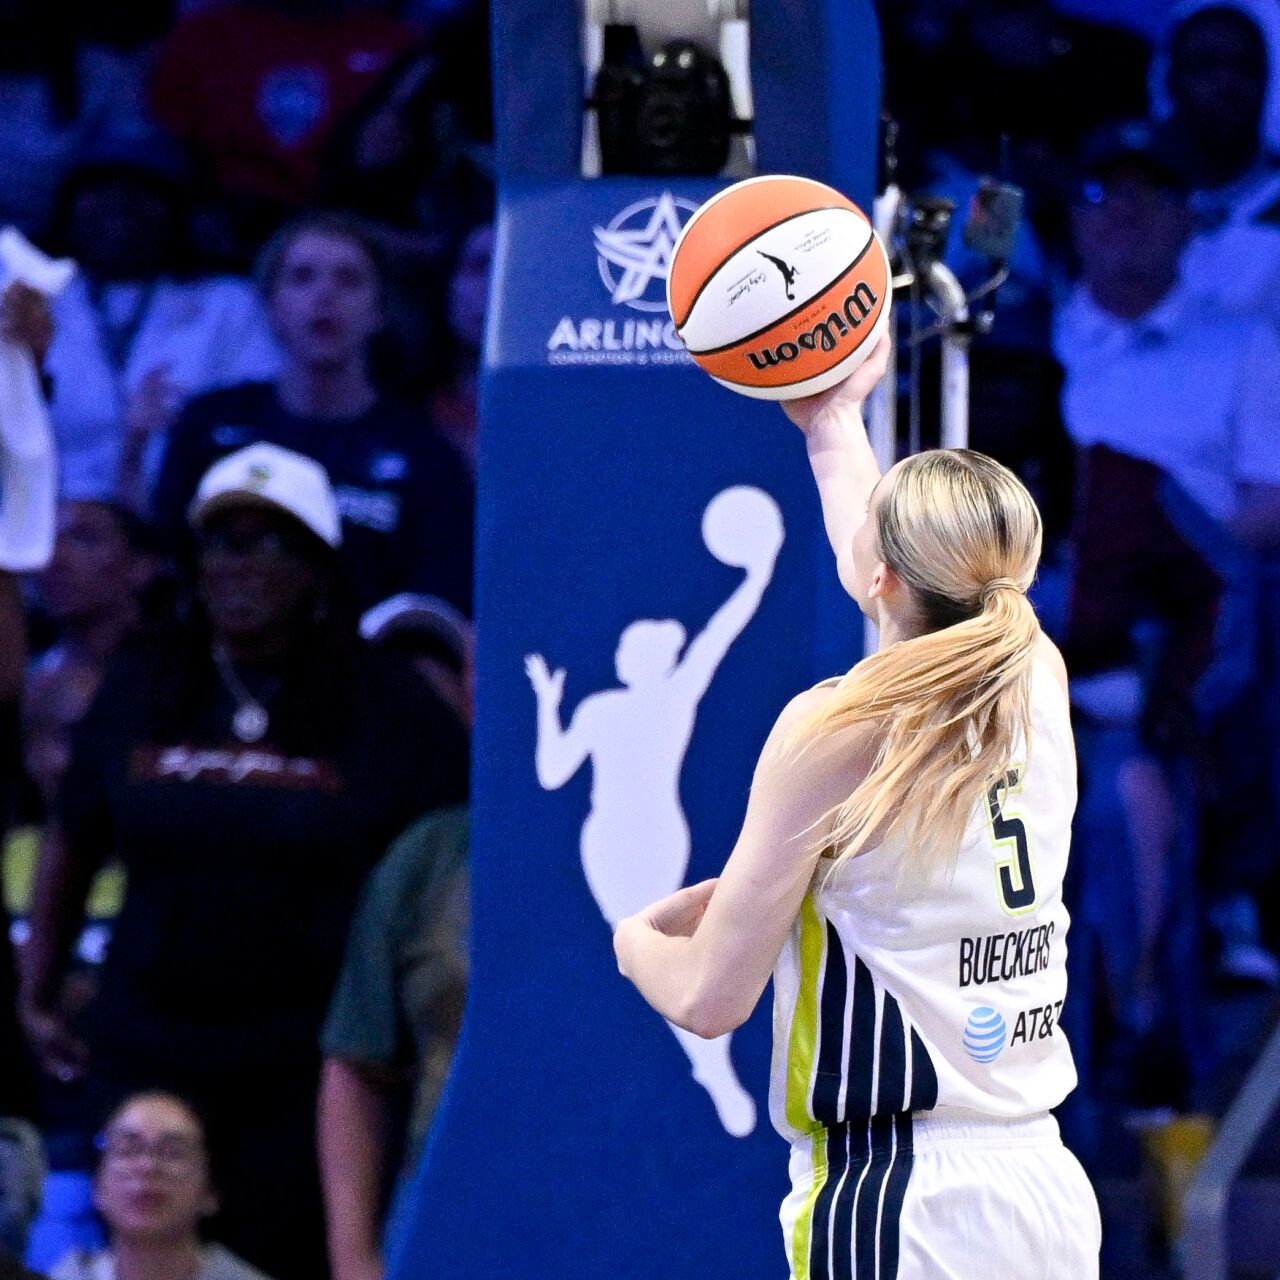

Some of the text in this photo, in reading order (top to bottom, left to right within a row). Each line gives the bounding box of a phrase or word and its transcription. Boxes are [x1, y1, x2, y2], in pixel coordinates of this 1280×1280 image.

[746, 281, 878, 371] Wilson
[984, 763, 1040, 916] 5
[959, 920, 1056, 988] BUECKERS
[1010, 1000, 1063, 1048] AT&T
